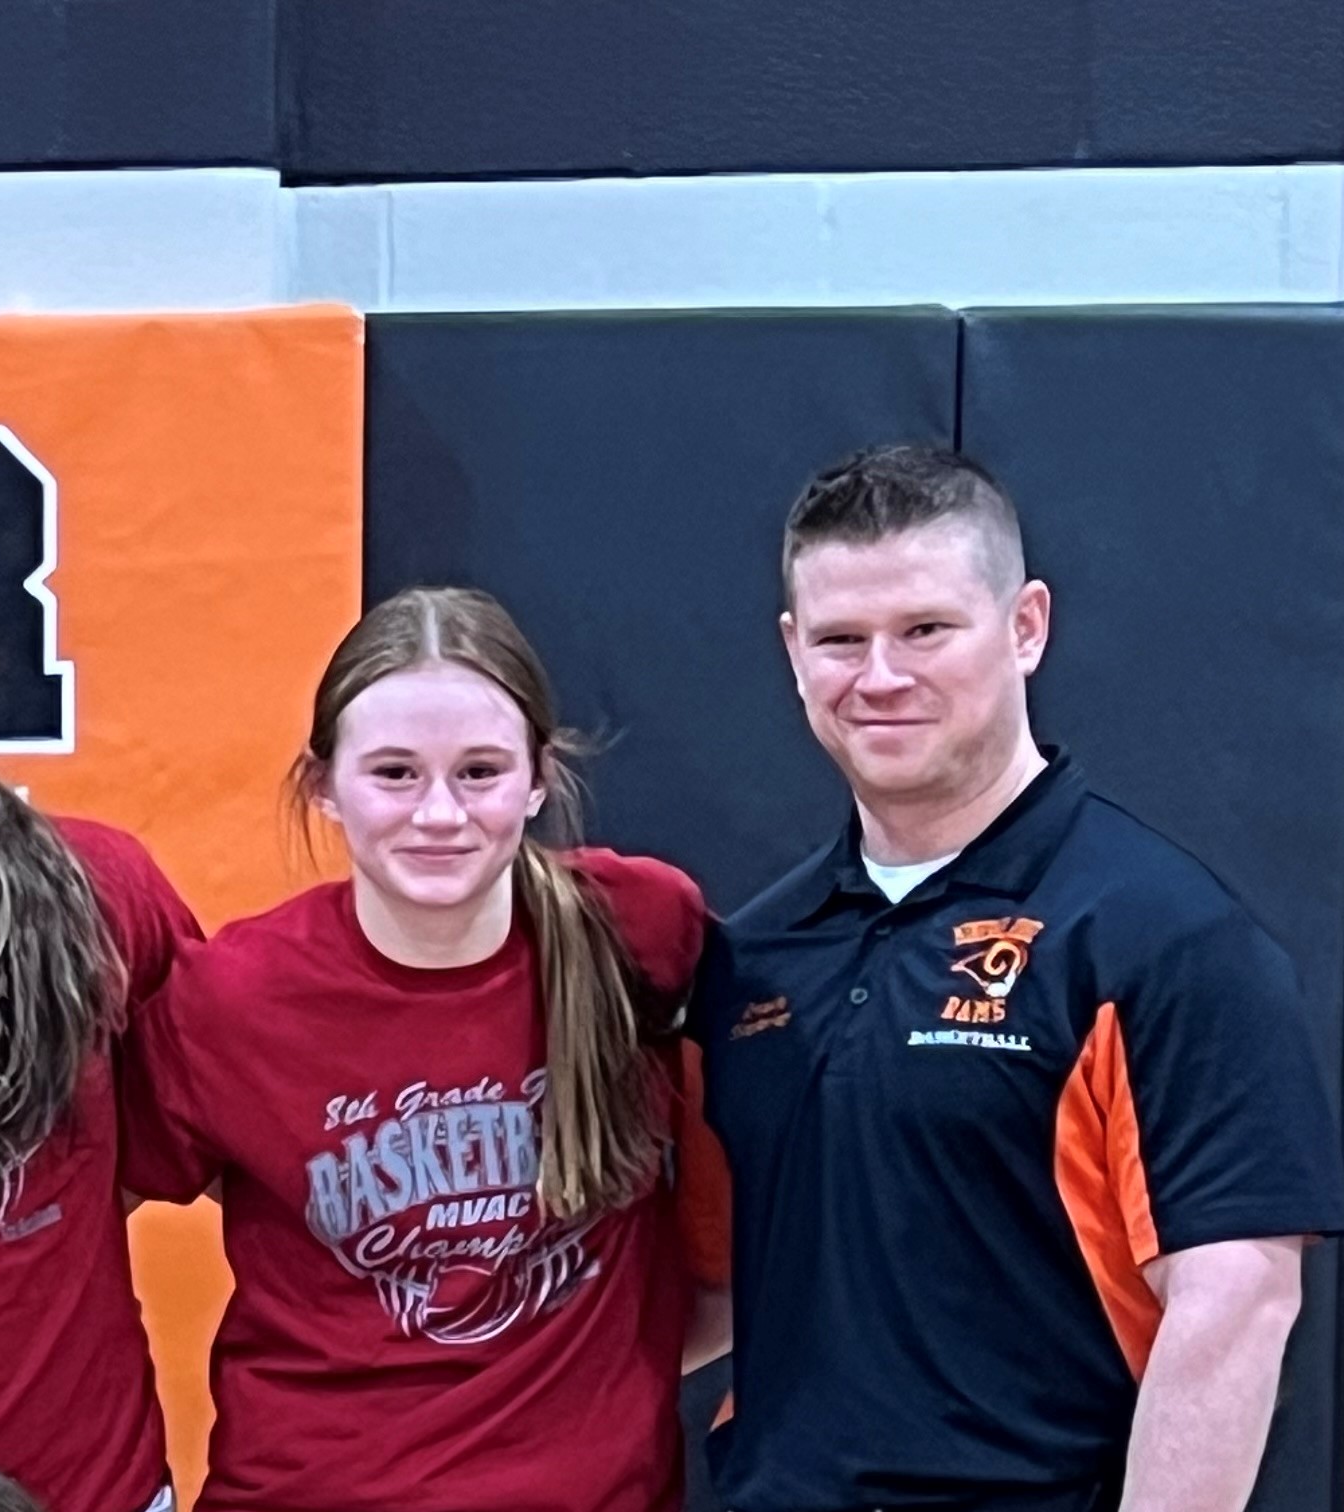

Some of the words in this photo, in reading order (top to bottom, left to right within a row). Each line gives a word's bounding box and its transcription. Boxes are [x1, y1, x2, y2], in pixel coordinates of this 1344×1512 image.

[940, 996, 1007, 1024] RAMS
[395, 1076, 507, 1121] Grade
[306, 1101, 539, 1247] BASKETB
[427, 1192, 532, 1231] MVAC
[356, 1223, 527, 1274] Champ
